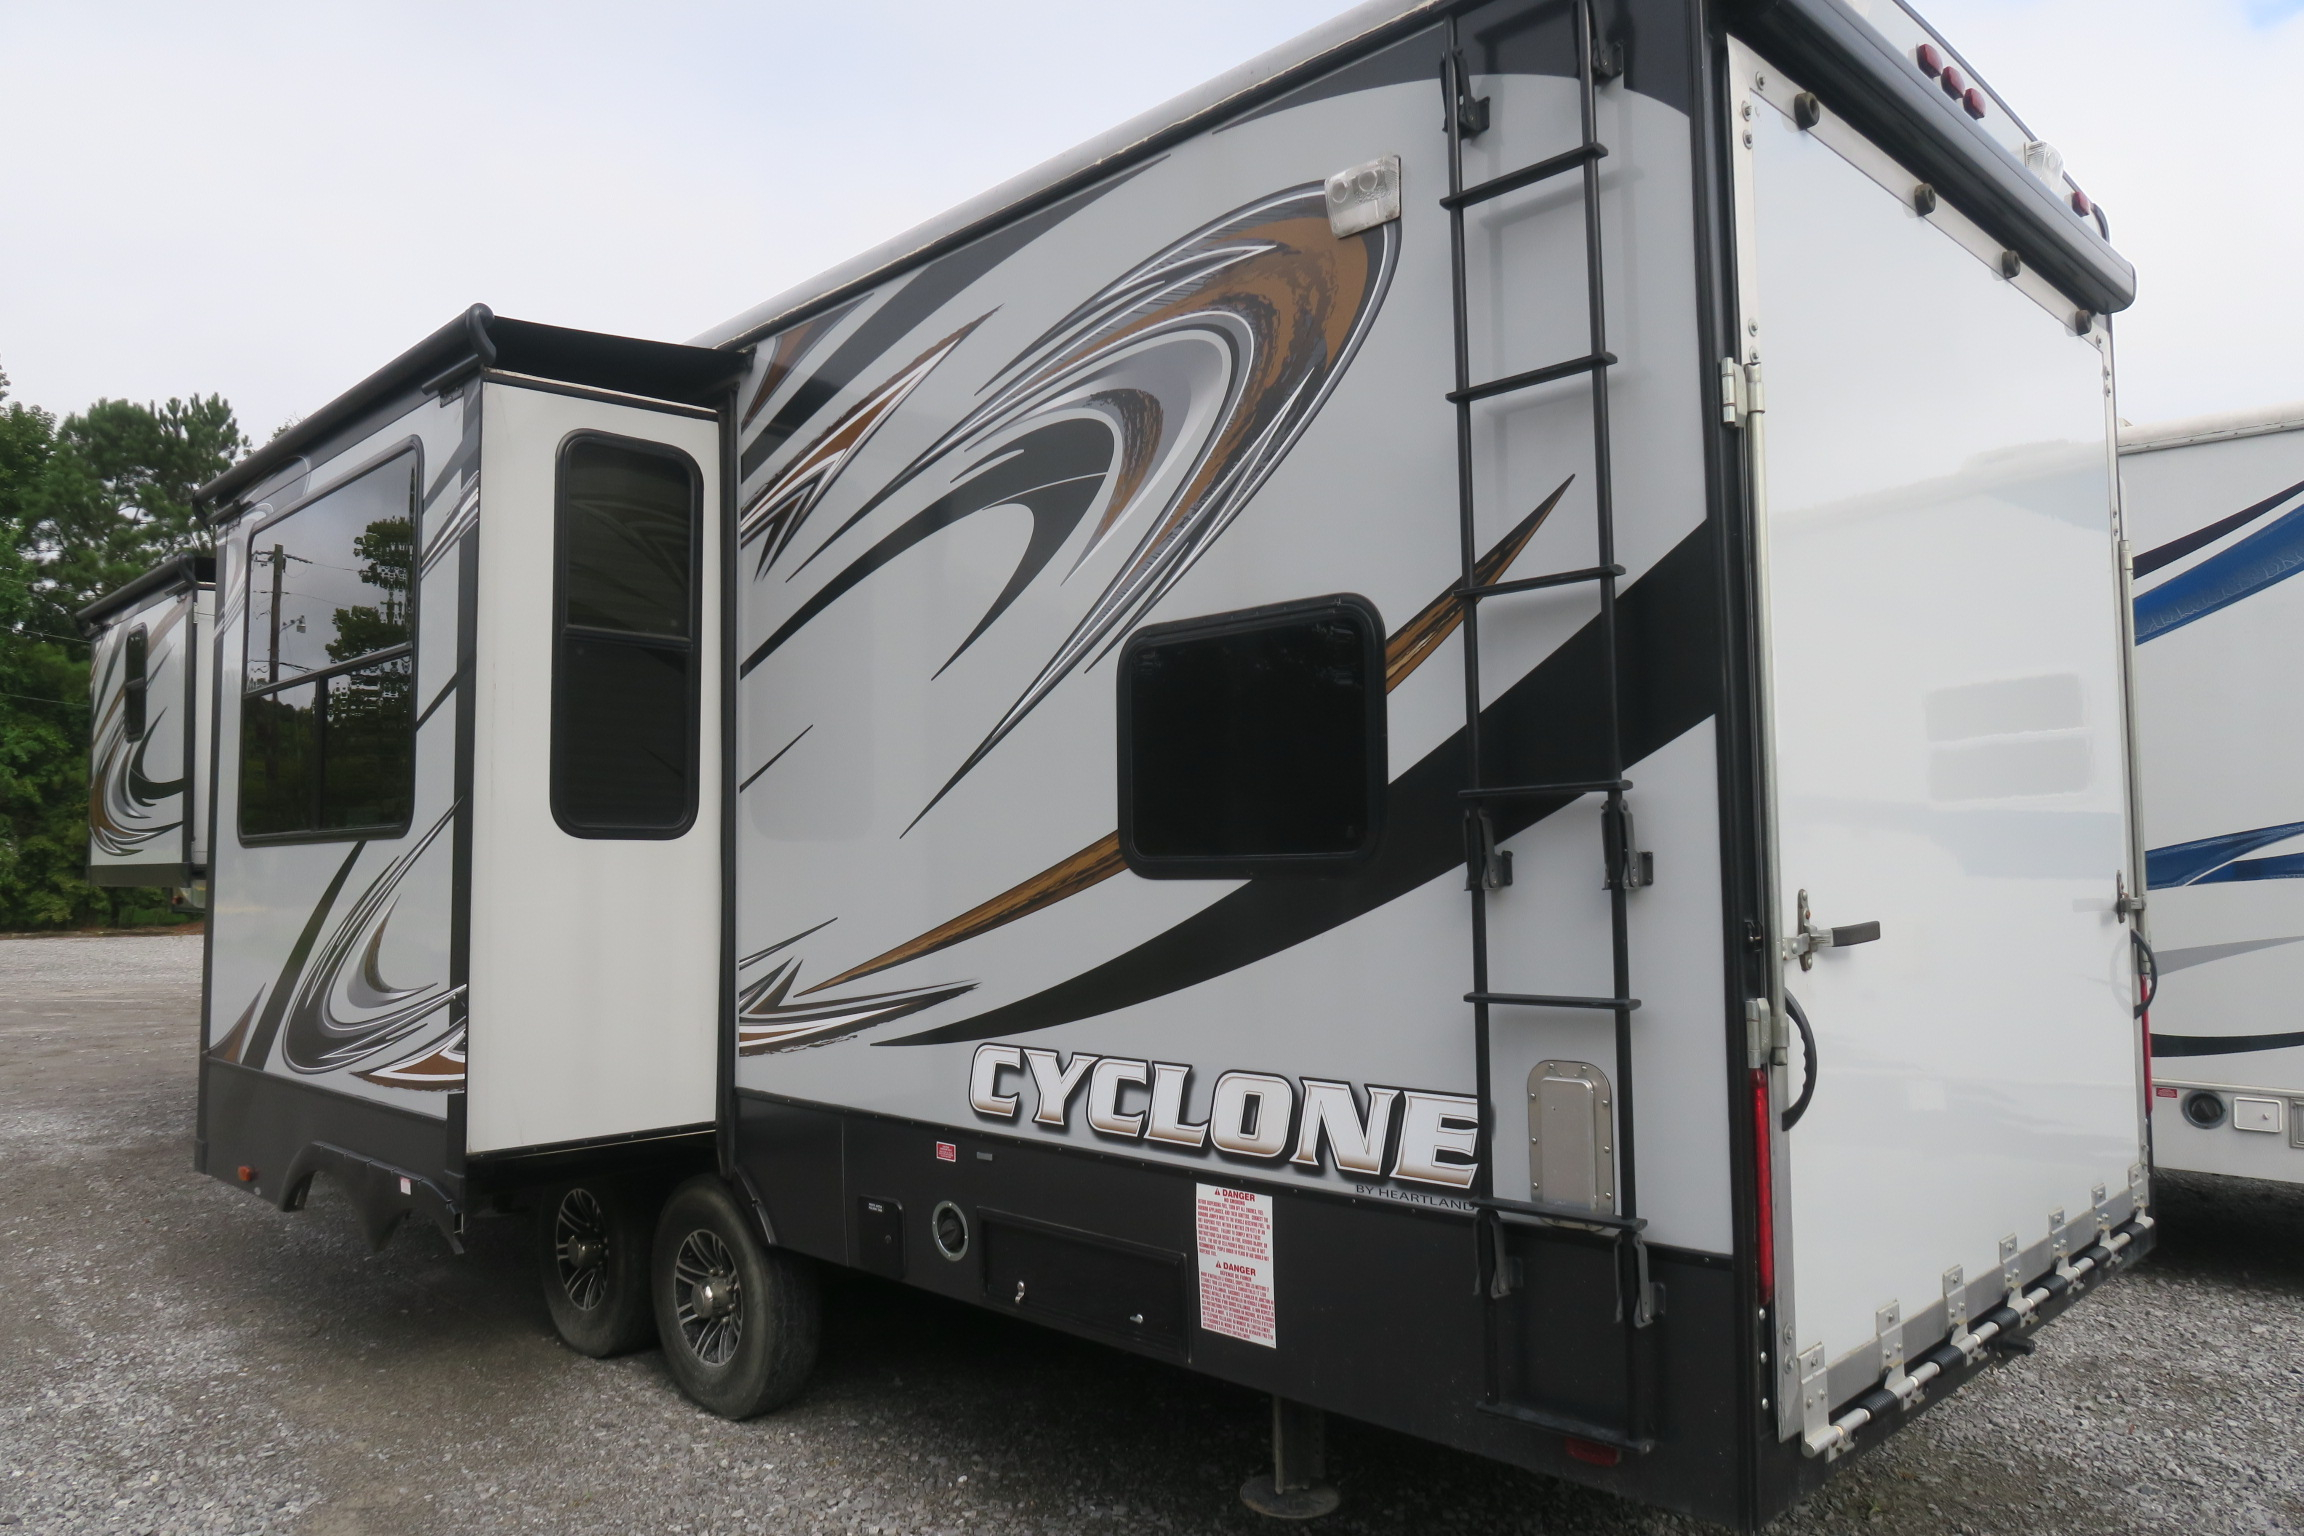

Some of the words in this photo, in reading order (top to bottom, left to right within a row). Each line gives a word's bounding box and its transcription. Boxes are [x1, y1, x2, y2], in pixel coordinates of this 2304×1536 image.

[969, 1042, 1478, 1190] CYCLONE
[1222, 1188, 1256, 1202] DANGER
[1356, 1184, 1375, 1195] BY
[1379, 1188, 1475, 1212] HEARTLAND
[1223, 1261, 1257, 1277] DANGER
